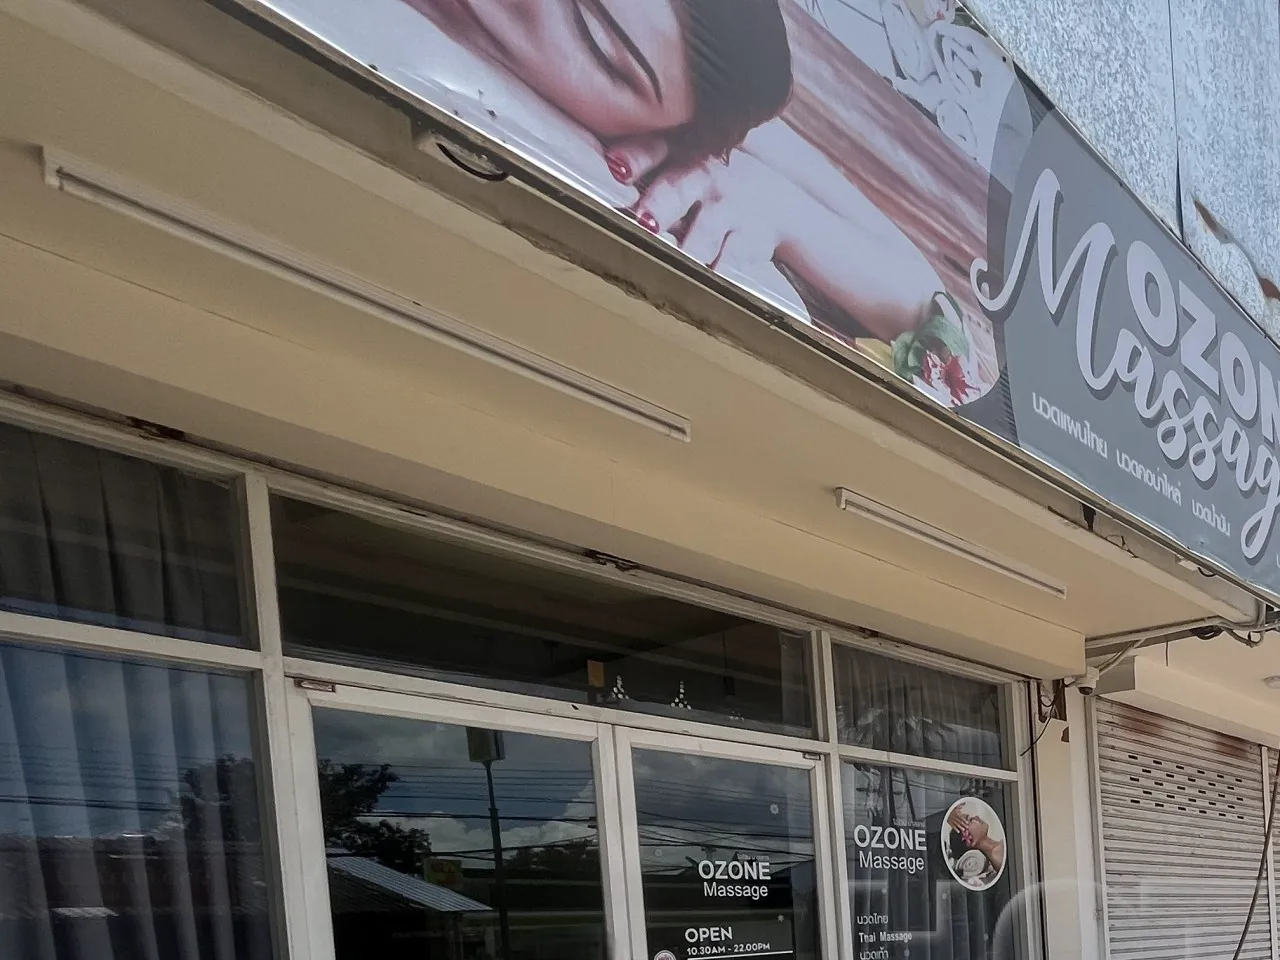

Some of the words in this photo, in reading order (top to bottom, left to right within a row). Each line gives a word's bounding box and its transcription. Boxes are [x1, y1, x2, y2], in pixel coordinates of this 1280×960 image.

[854, 825, 927, 851] OZONE
[698, 860, 772, 880] OZONE
[859, 851, 925, 874] Massage
[703, 881, 769, 901] Massage
[857, 912, 888, 925] นวดไทย
[684, 926, 733, 943] OPEN
[880, 931, 913, 943] Massage
[686, 946, 726, 956] 10.30AM
[733, 943, 771, 953] 22.00PM
[859, 946, 889, 960] นวดเท้า
